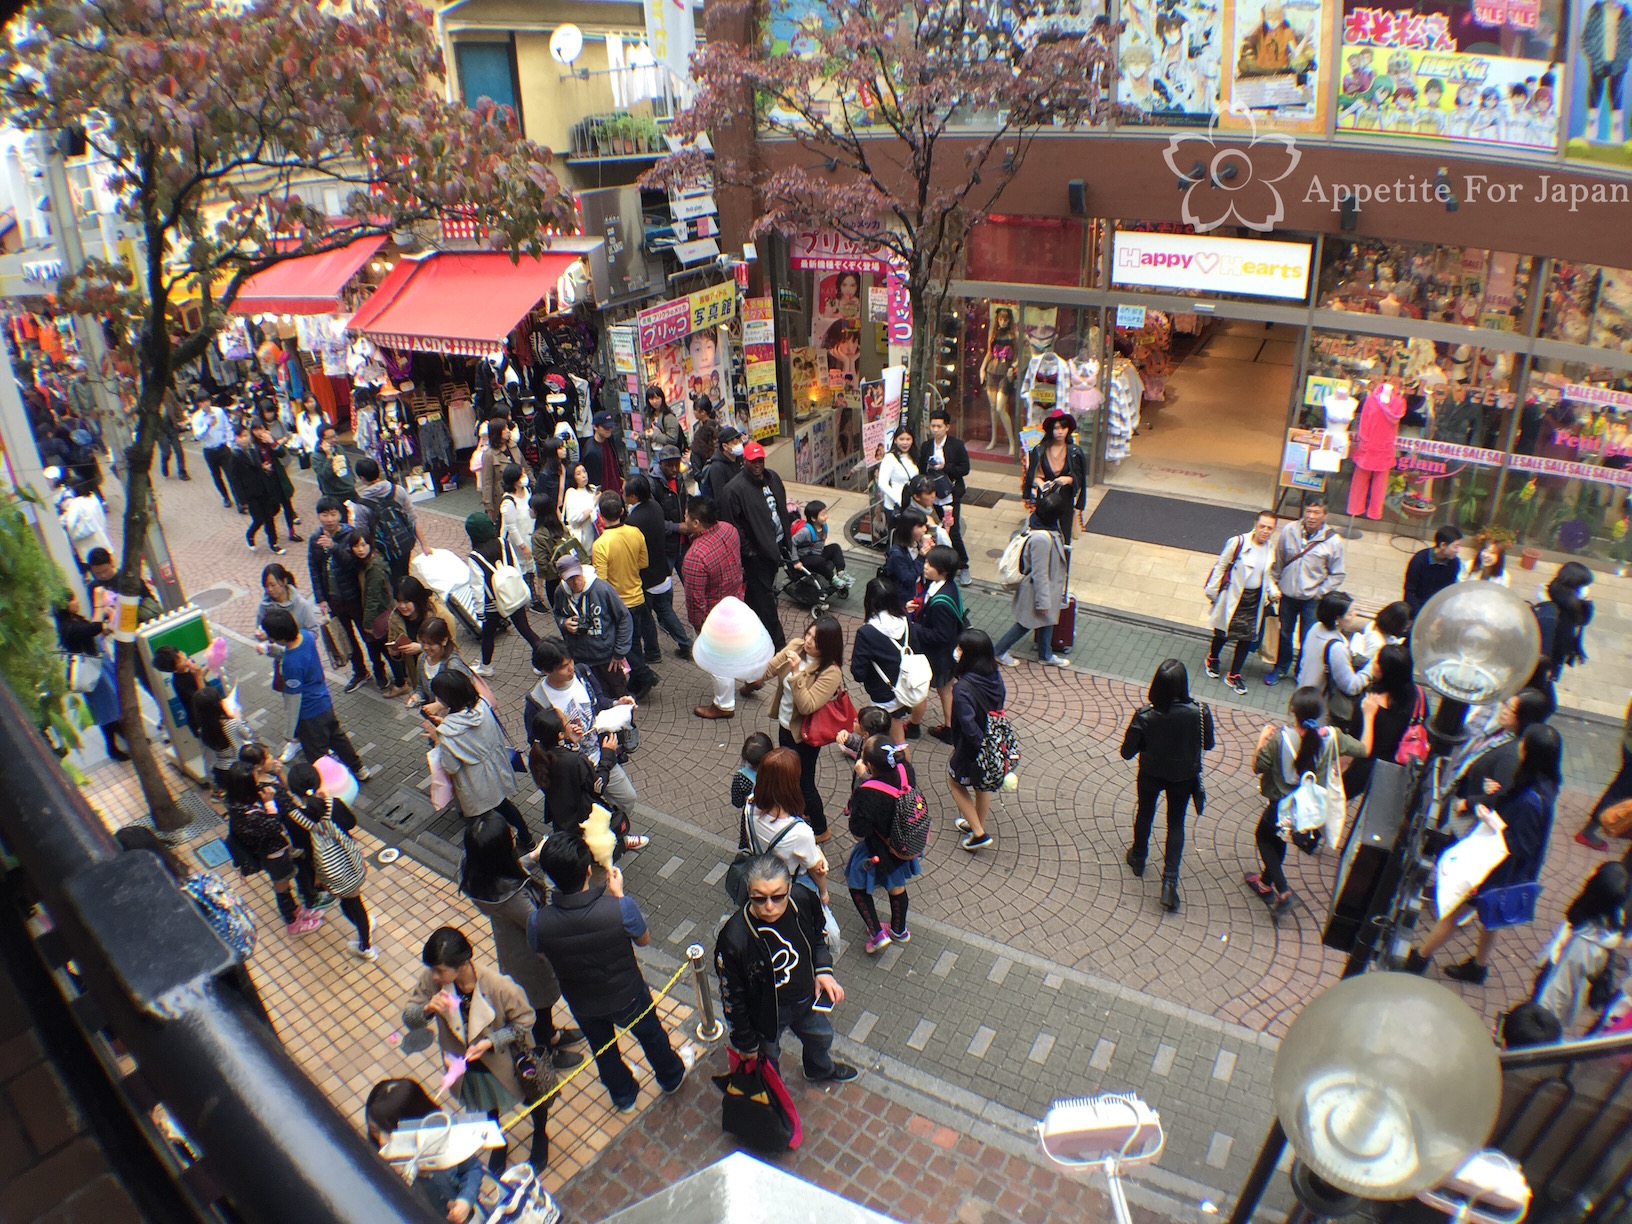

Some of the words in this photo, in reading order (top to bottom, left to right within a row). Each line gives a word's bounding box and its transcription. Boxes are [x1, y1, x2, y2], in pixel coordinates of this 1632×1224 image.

[1343, 7, 1458, 51] おそ松さん
[800, 259, 880, 272] 最新機種ぞくぞく登場
[1118, 247, 1194, 269] Happy
[1219, 255, 1303, 279] Hearts
[694, 296, 732, 326] 写真館
[643, 316, 688, 346] プリッコ
[412, 337, 452, 354] ACDC
[1566, 384, 1591, 399] SALE
[1591, 388, 1616, 404] SALE
[1413, 440, 1437, 452] SALE
[1438, 443, 1461, 456] SALE
[1462, 446, 1486, 460] SALE
[1554, 429, 1602, 451] Petit
[1397, 454, 1447, 473] glam
[1519, 456, 1543, 469] SALE
[1543, 459, 1568, 473] SALE
[1567, 463, 1593, 477] SALE
[1592, 466, 1617, 480] SALE
